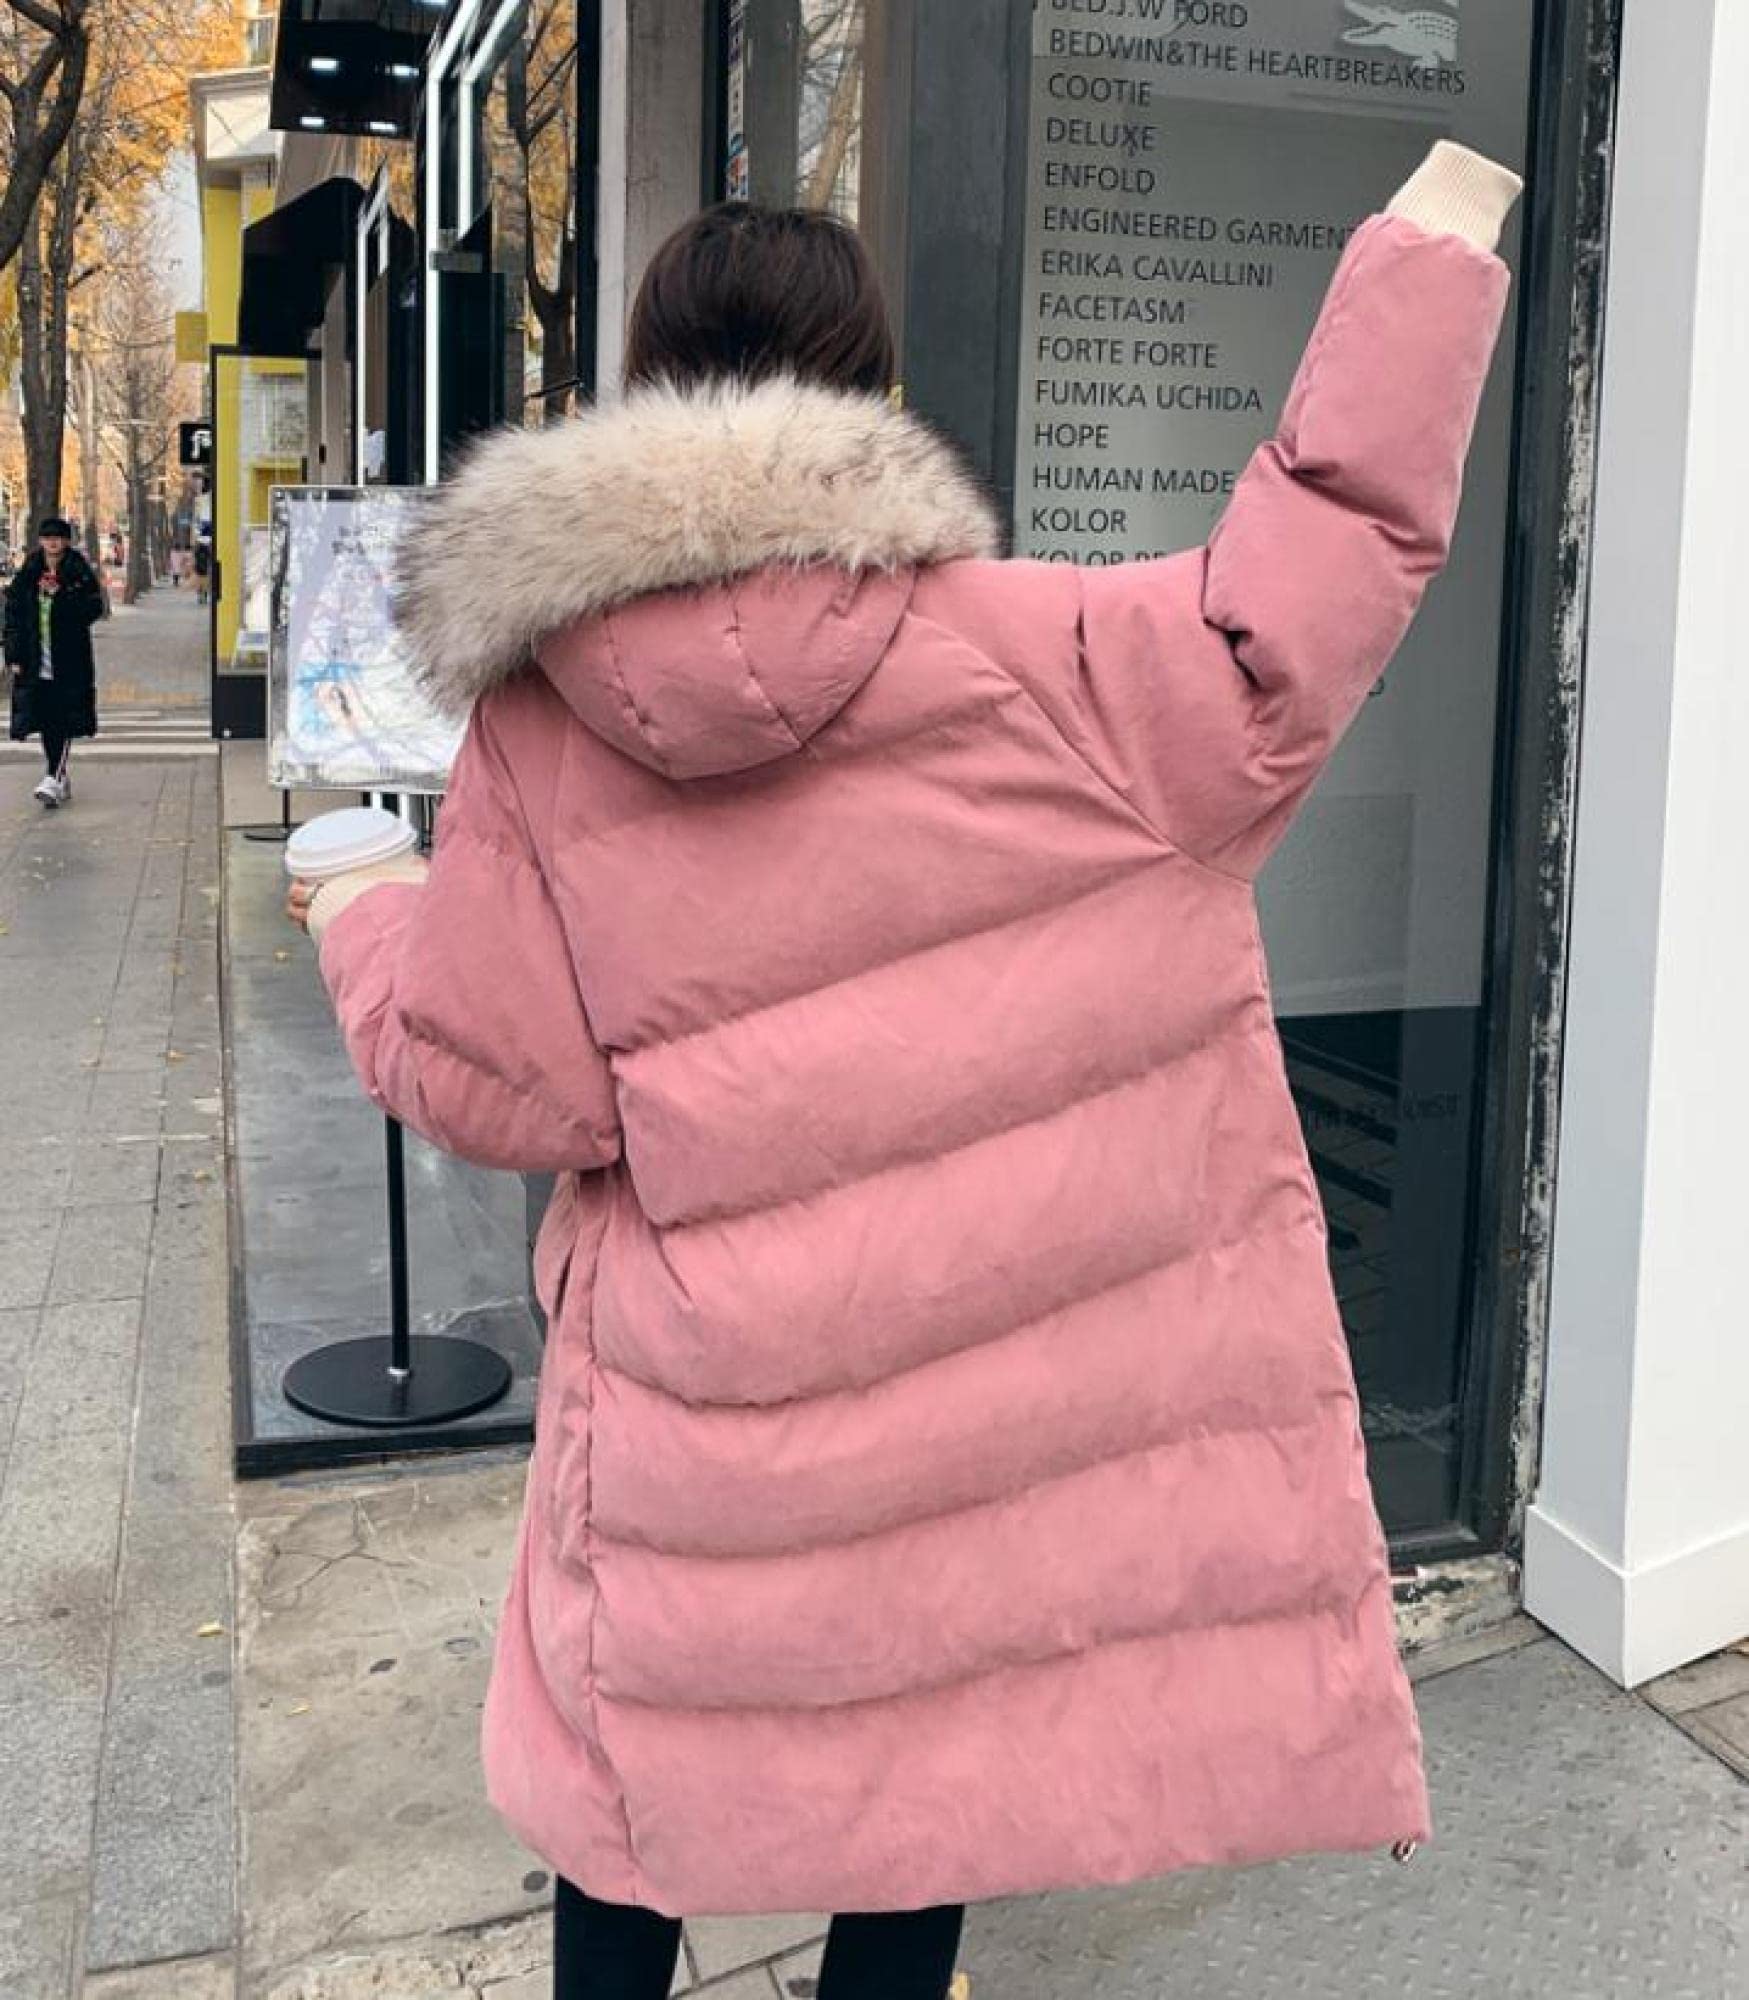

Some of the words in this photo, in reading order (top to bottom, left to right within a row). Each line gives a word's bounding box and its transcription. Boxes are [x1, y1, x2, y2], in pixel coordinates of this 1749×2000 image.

[1173, 0, 1248, 28] FORD
[1050, 28, 1238, 73] BEDWIN&THE
[1247, 47, 1465, 94] HEARTBREAKERS
[1048, 72, 1151, 107] COOTIE
[1046, 117, 1157, 152] DELUXE
[1045, 162, 1155, 195] ENFOLD
[1043, 206, 1216, 242] ENGINEERED
[1041, 250, 1123, 279] ERIKA
[1133, 255, 1272, 286] CAVALLINI
[1038, 291, 1185, 325] FACETASM
[1037, 336, 1123, 365] FORTE
[1134, 341, 1218, 369] FORTE
[1036, 379, 1147, 408] FUMIKA
[1157, 384, 1263, 412] UCHIDA
[1034, 423, 1109, 449] HOPE
[1032, 465, 1143, 492] HUMAN
[1151, 469, 1236, 494] MADE
[1031, 508, 1127, 533] KOLOR
